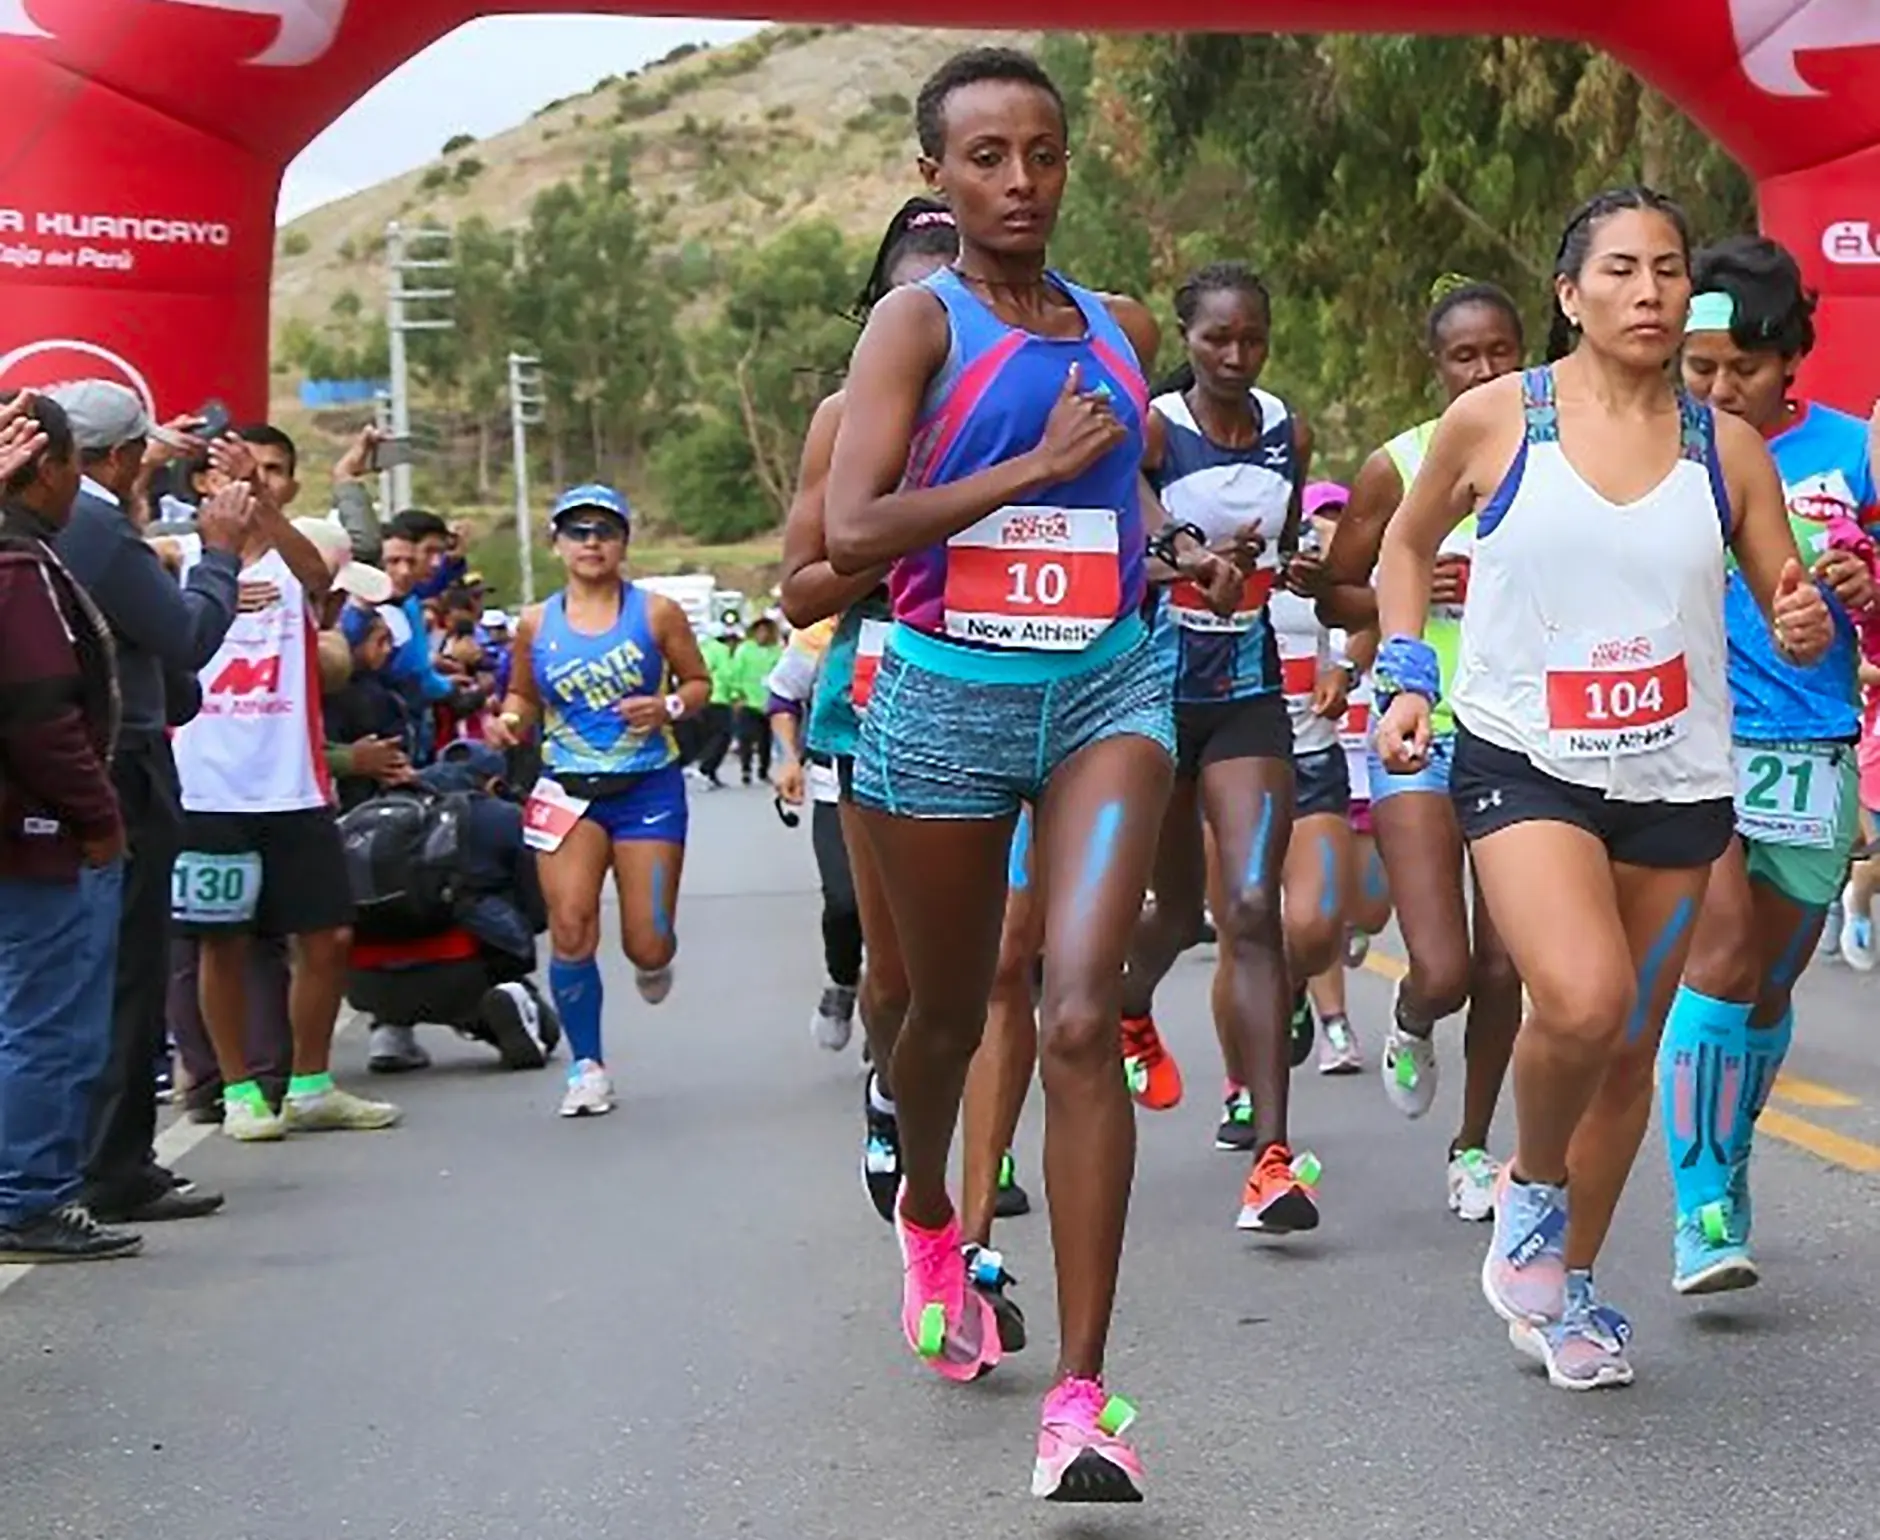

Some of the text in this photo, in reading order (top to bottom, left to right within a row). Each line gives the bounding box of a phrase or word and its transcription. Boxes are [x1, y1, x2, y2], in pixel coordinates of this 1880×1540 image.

[36, 212, 229, 245] HUANCAYO
[1005, 562, 1068, 605] 10
[967, 618, 1014, 639] New
[553, 639, 646, 703] PENTA
[585, 664, 645, 712] RUN
[1584, 676, 1664, 720] 104
[1569, 734, 1612, 752] New
[1744, 754, 1814, 812] 21
[172, 865, 245, 902] 130
